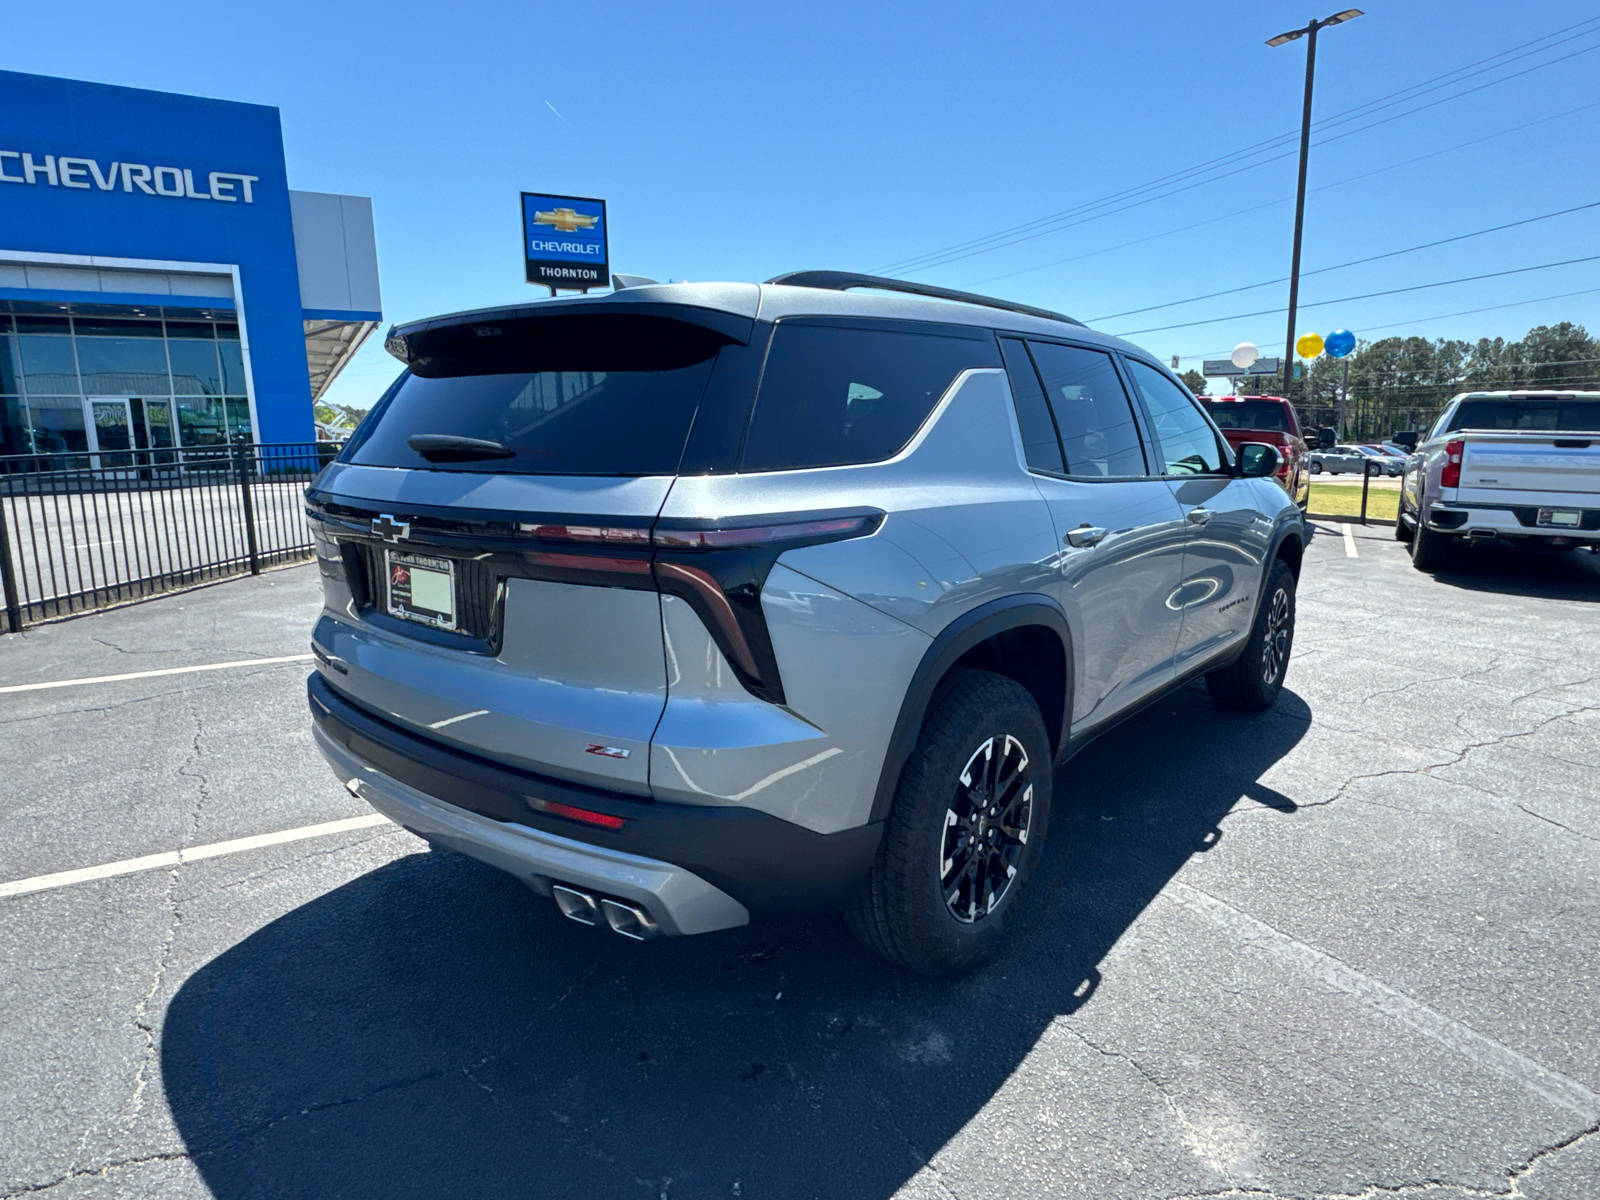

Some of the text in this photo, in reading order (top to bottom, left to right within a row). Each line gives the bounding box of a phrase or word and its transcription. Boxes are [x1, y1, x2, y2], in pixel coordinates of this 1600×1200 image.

[0, 150, 259, 203] CHEVROLET
[532, 240, 600, 254] CHEVROLET
[540, 267, 597, 279] THORNTON
